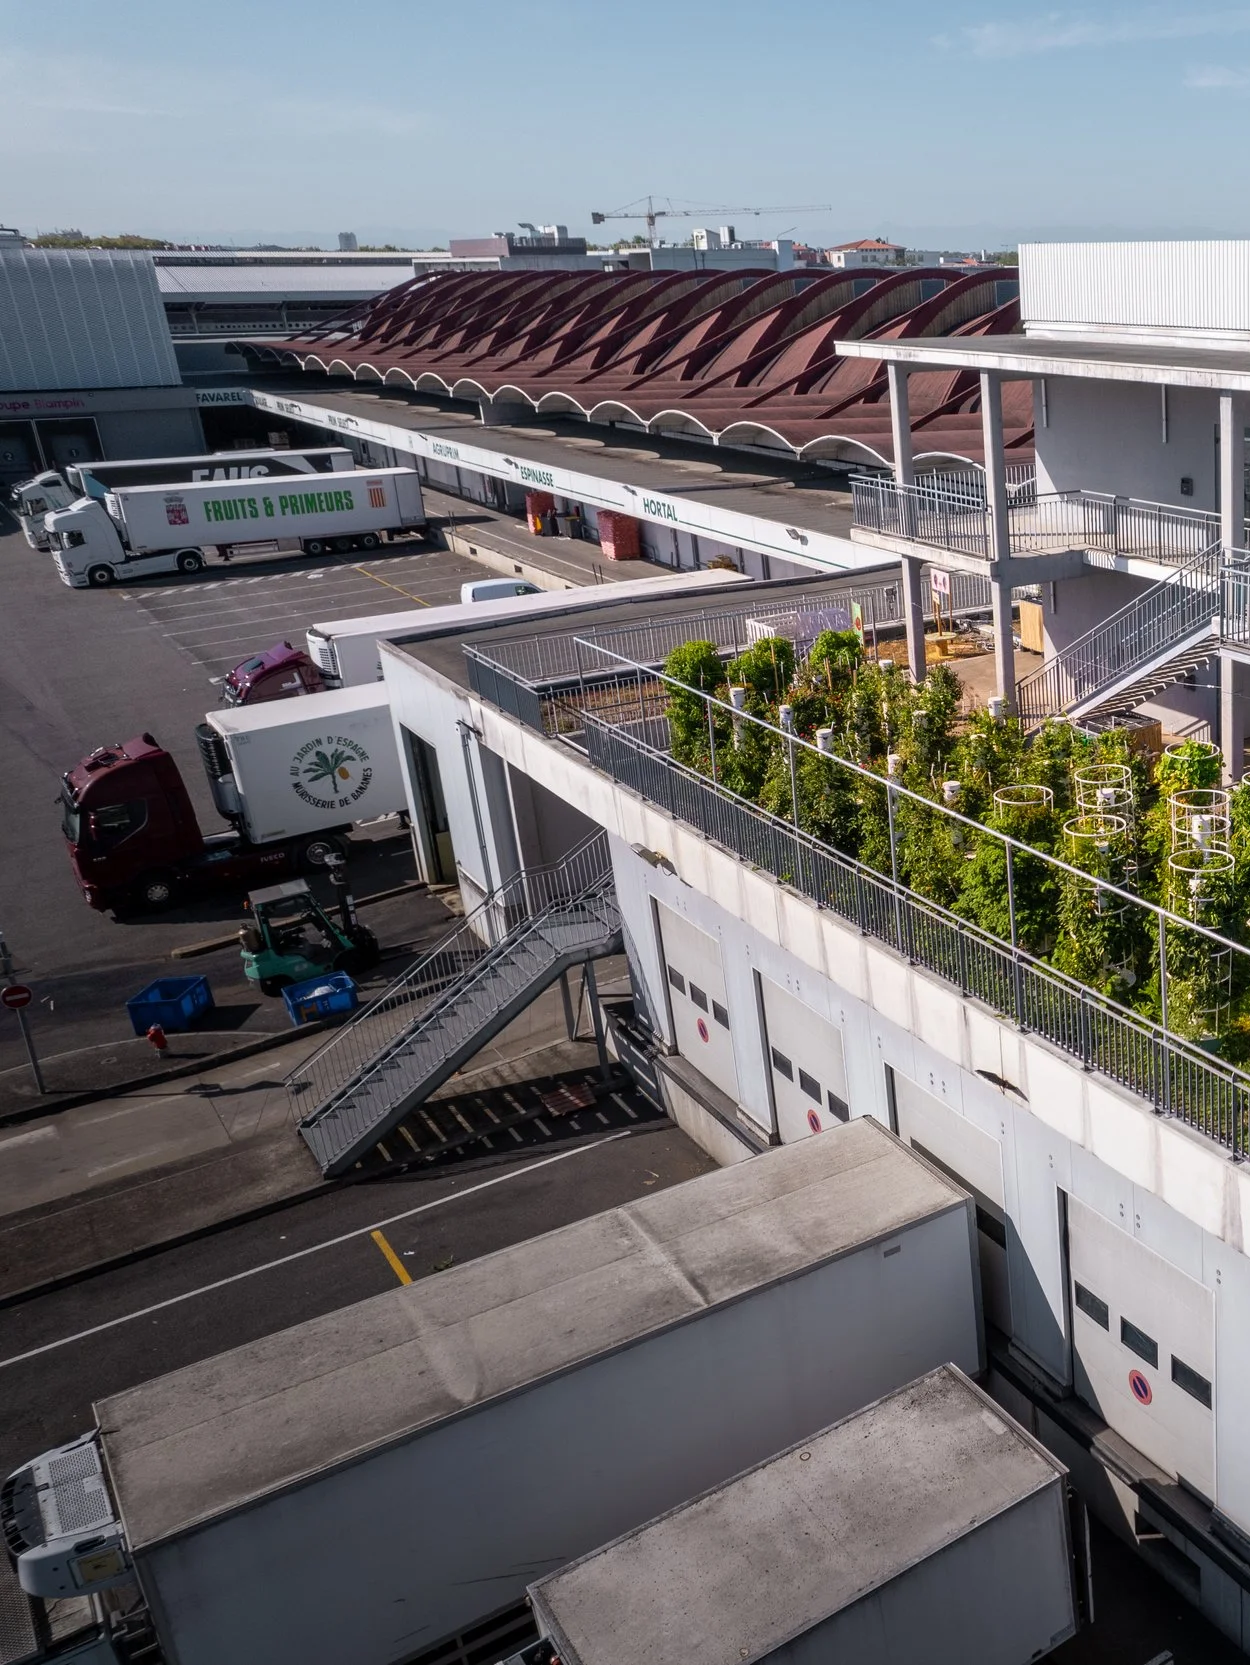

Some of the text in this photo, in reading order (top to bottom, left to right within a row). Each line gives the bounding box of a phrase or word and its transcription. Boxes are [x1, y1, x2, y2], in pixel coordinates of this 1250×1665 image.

[196, 391, 243, 403] FAVAREL
[432, 442, 459, 460] AGRUPRIM
[520, 466, 553, 487] ESPINASSE
[203, 490, 354, 522] FRUITS & PRIMEURS
[643, 498, 678, 522] HORTAL
[290, 735, 369, 777] AU JARDIN D'ESPAGNE
[292, 767, 372, 809] MURISSERIE DE BANANES
[260, 852, 285, 863] IVECO
